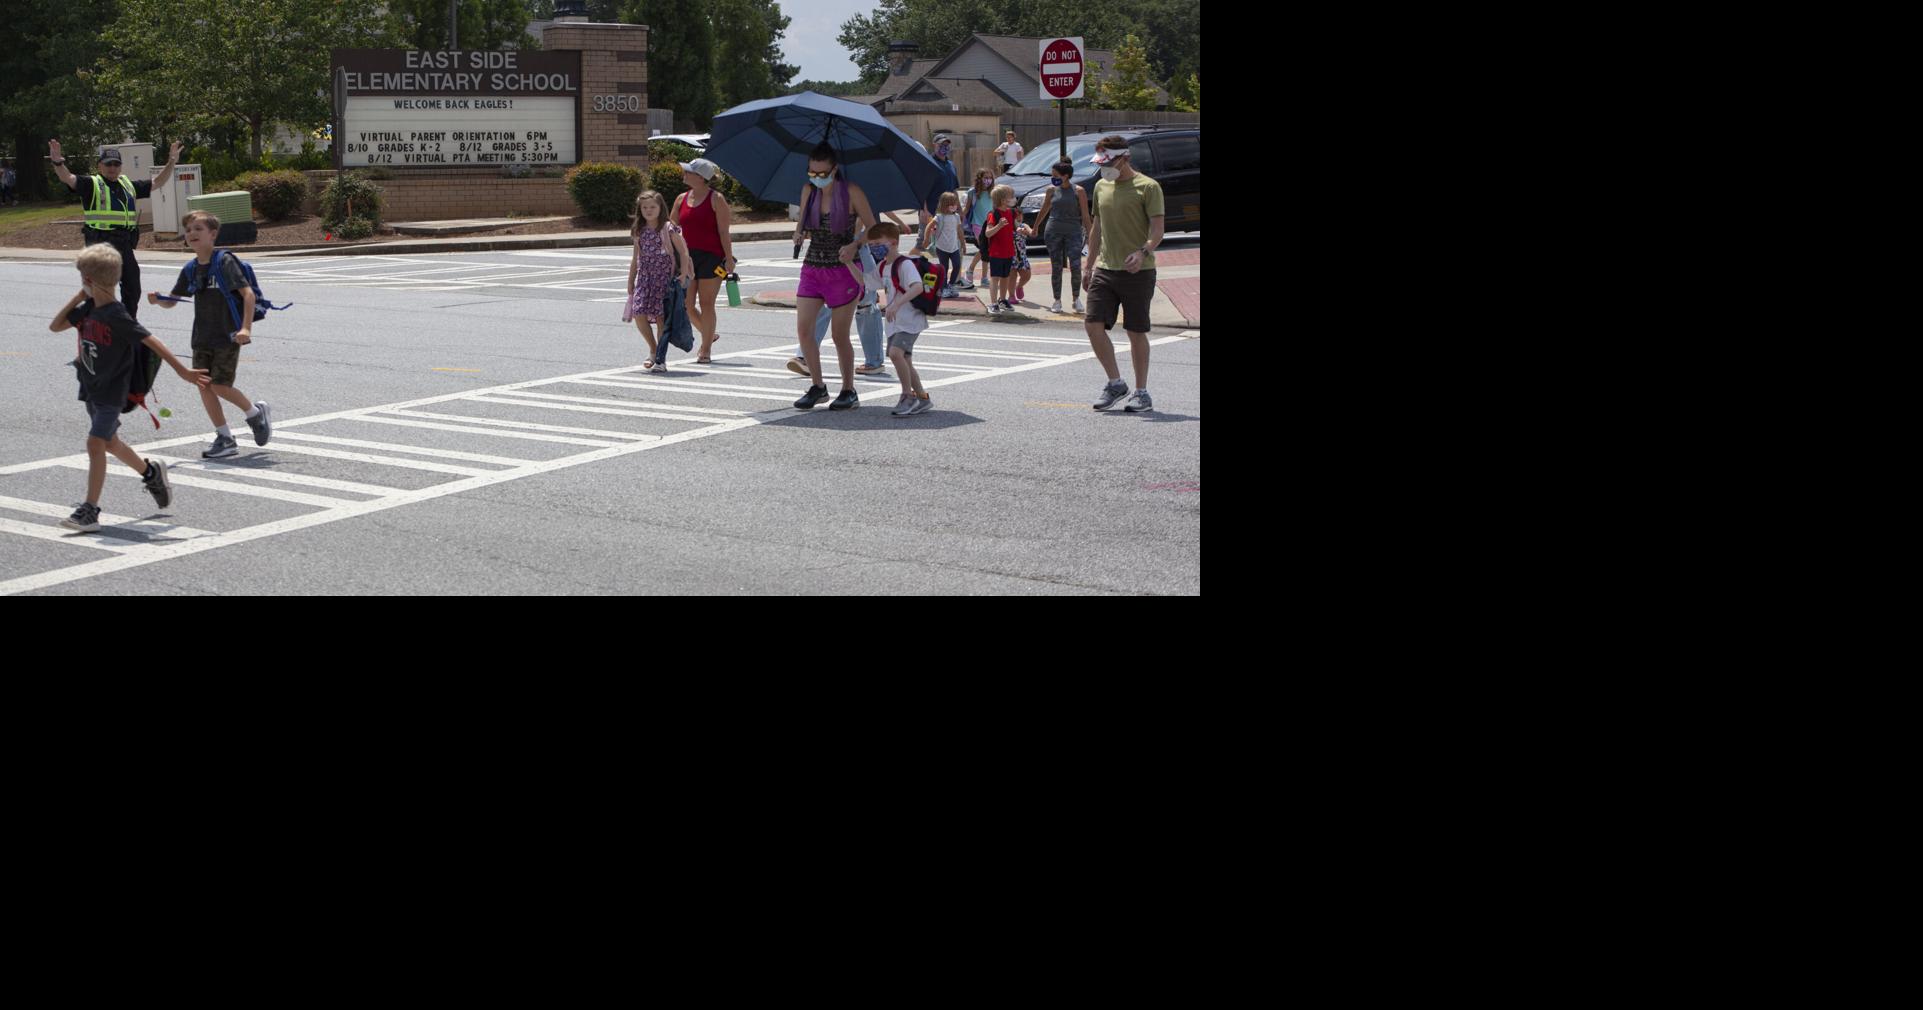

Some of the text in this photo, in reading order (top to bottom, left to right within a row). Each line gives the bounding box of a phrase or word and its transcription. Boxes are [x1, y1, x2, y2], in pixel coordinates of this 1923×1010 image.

[406, 51, 517, 69] EAST SIDE
[1047, 50, 1076, 61] DO NOT
[346, 72, 577, 91] ELEMENTARY SCHOOL
[1049, 77, 1074, 87] ENTER
[394, 100, 513, 109] WELCOME BACK EAGLES!
[593, 95, 639, 112] 3850
[360, 131, 548, 142] VIRTUAL PARENT ORIENTATION 6PM
[347, 143, 368, 152] 8/10
[378, 143, 414, 152] GRADES
[459, 142, 482, 151] 8/12
[492, 142, 527, 151] GRADES
[368, 153, 558, 163] 8/12 VIRTUAL PTA MEETING 5:30PM
